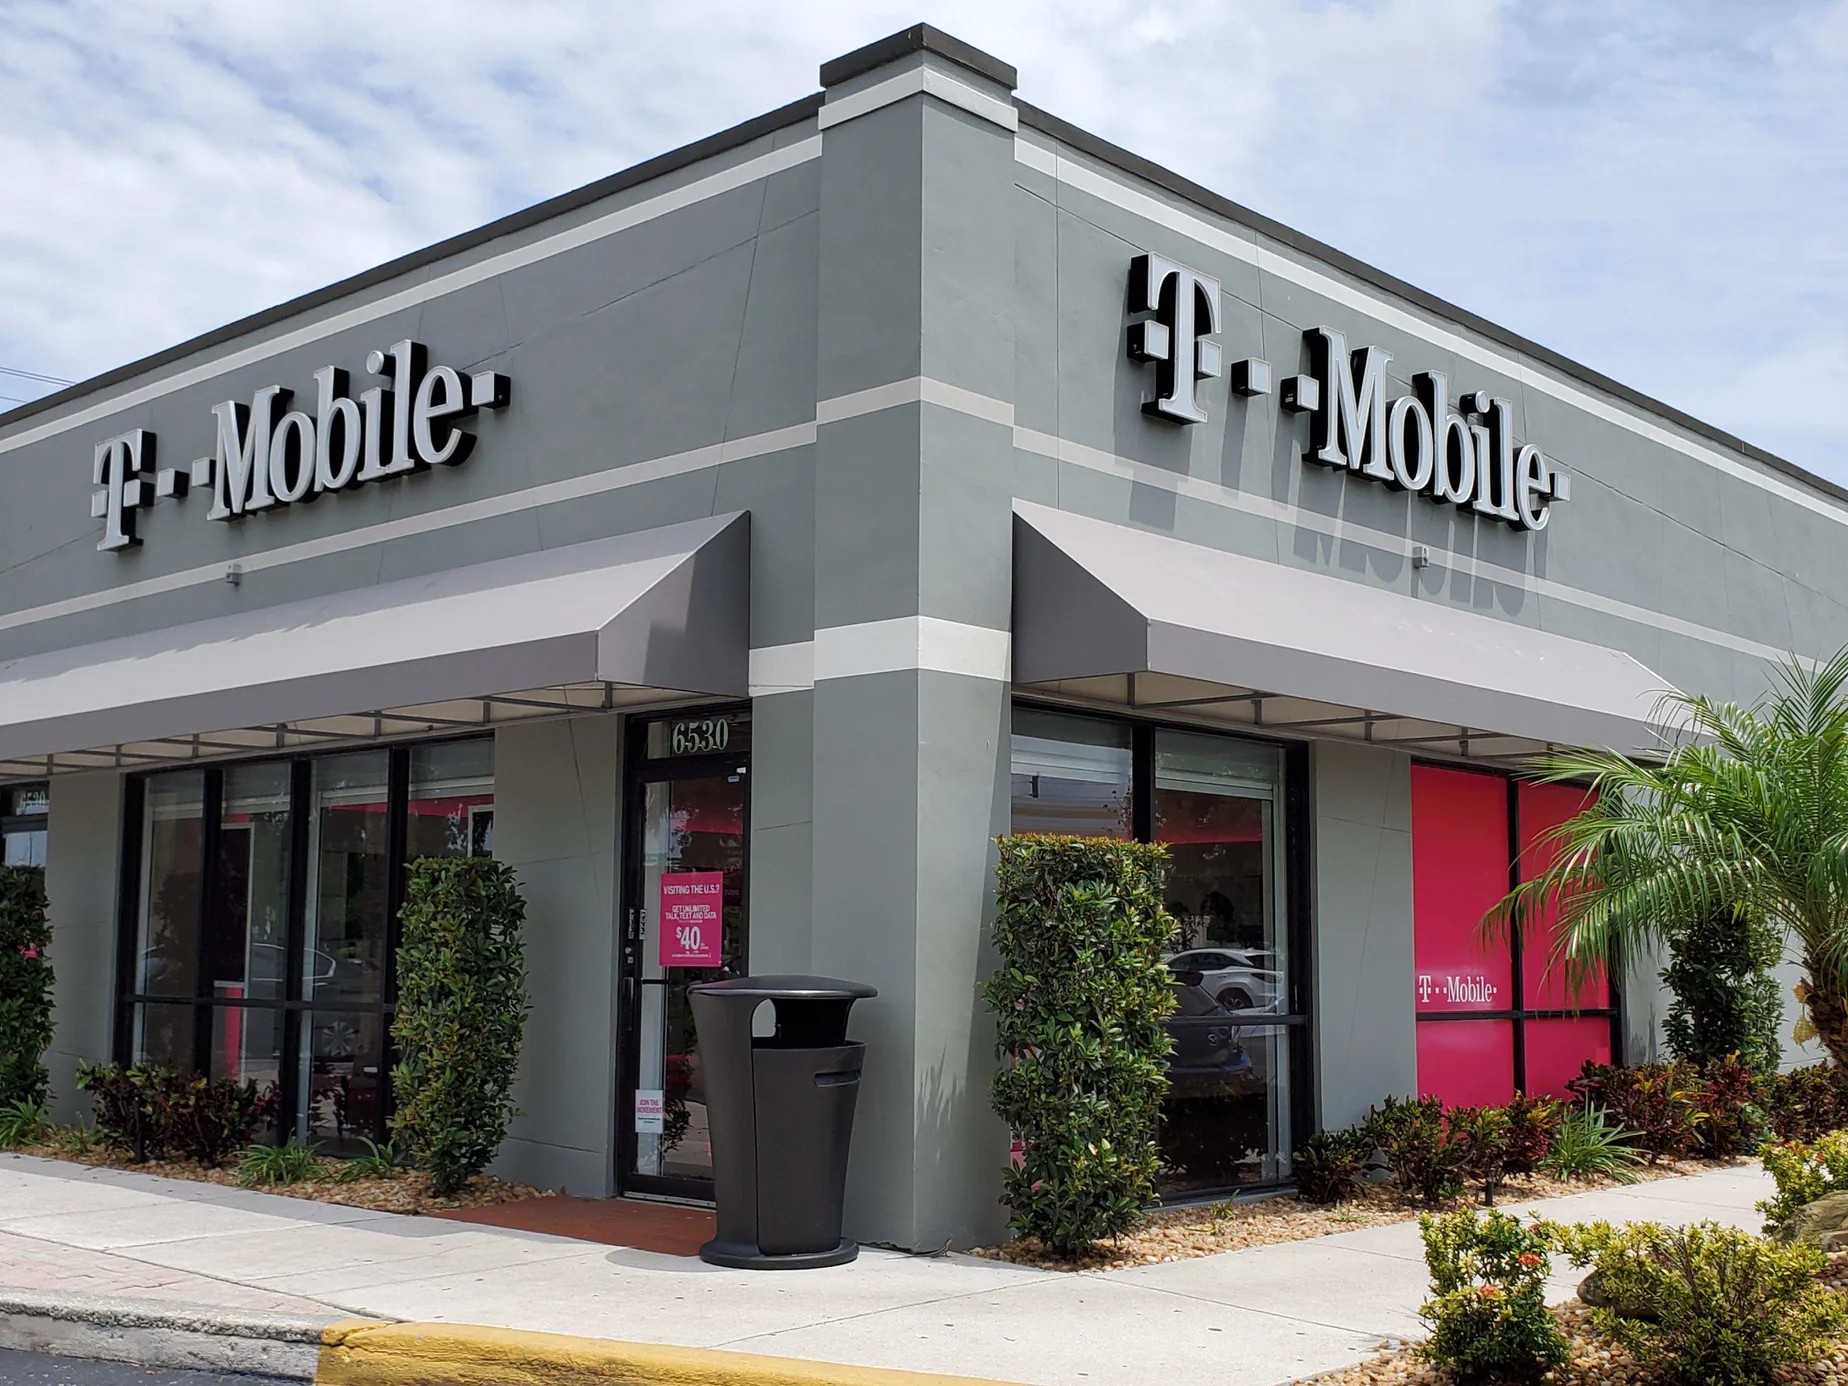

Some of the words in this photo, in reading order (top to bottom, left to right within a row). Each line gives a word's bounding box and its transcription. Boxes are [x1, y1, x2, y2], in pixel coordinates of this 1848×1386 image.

[672, 718, 729, 754] 6530
[663, 885, 690, 895] VISITING
[690, 885, 703, 894] THE
[704, 884, 720, 894] U.S.?
[683, 904, 710, 912] UNLIMITED
[704, 911, 717, 919] DATA
[676, 926, 701, 950] $40
